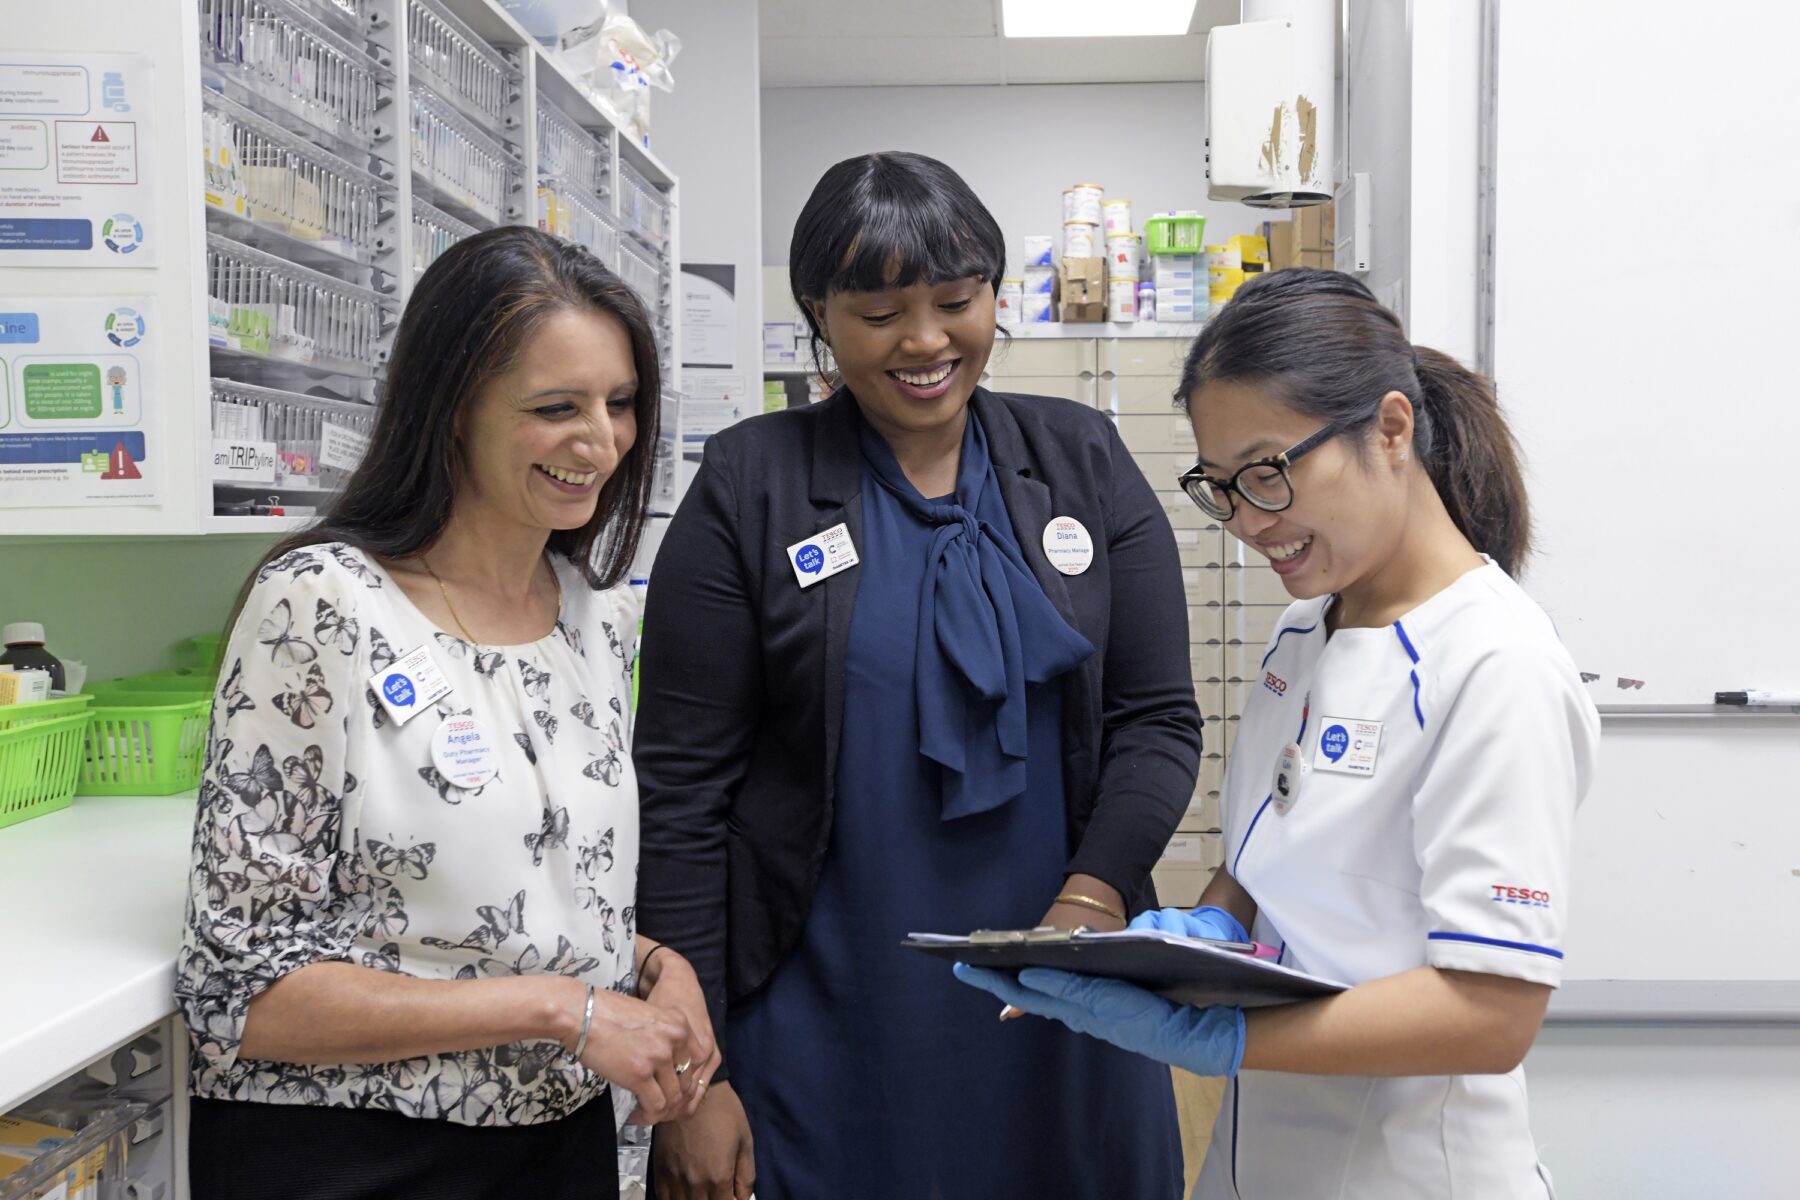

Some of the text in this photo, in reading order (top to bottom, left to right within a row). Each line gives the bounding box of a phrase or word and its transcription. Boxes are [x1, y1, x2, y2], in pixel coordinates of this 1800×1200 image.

[214, 446, 273, 470] amiTRIPtyline
[822, 527, 843, 540] TESCO
[1056, 532, 1078, 540] Diana
[798, 548, 819, 562] Let's
[803, 557, 821, 570] talk
[404, 651, 427, 666] TESCO
[384, 677, 408, 695] Let's
[393, 687, 414, 703] talk
[447, 720, 475, 729] TESCO
[1356, 723, 1378, 732] TESCO
[447, 731, 481, 745] Angela
[1325, 731, 1347, 743] Let's
[459, 746, 490, 756] Pharmacy
[1325, 742, 1344, 754] talk
[1491, 885, 1550, 903] TESCO
